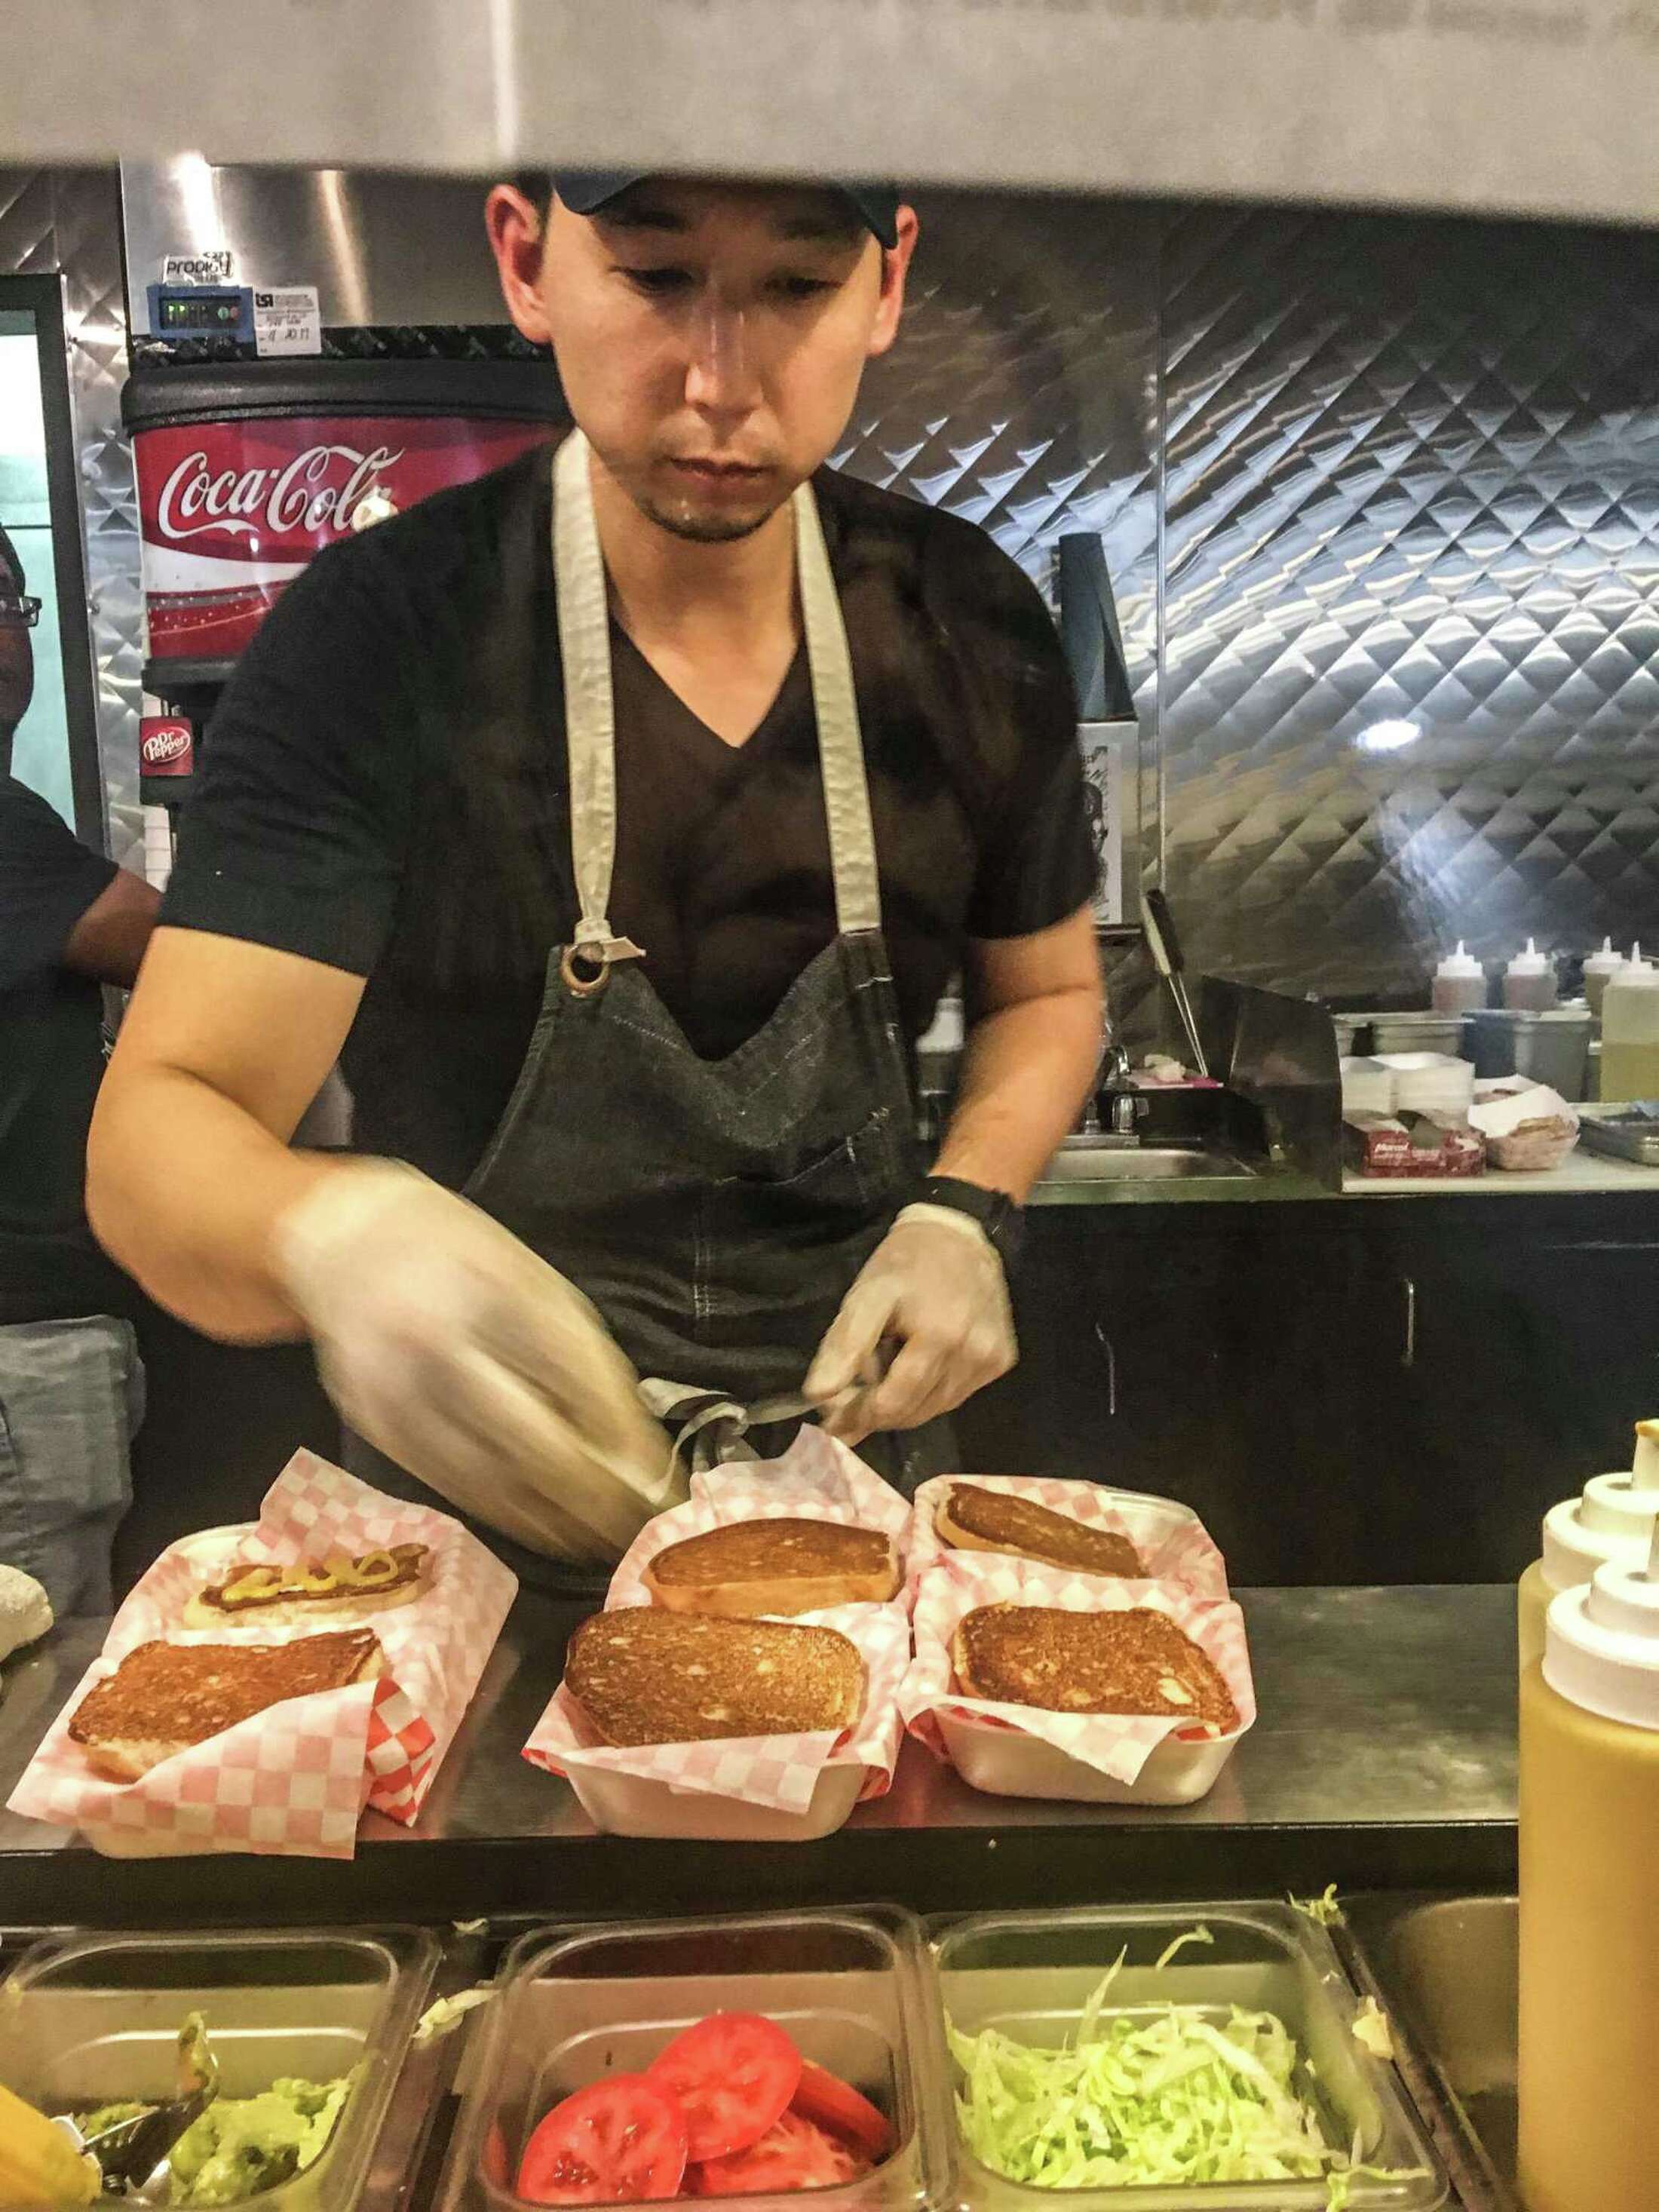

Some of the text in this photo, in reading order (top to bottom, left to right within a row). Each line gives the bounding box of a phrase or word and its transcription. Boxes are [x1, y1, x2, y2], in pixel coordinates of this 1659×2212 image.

[158, 446, 406, 539] Coca-Col
[147, 735, 187, 761] Pepper
[158, 732, 175, 745] Dr
